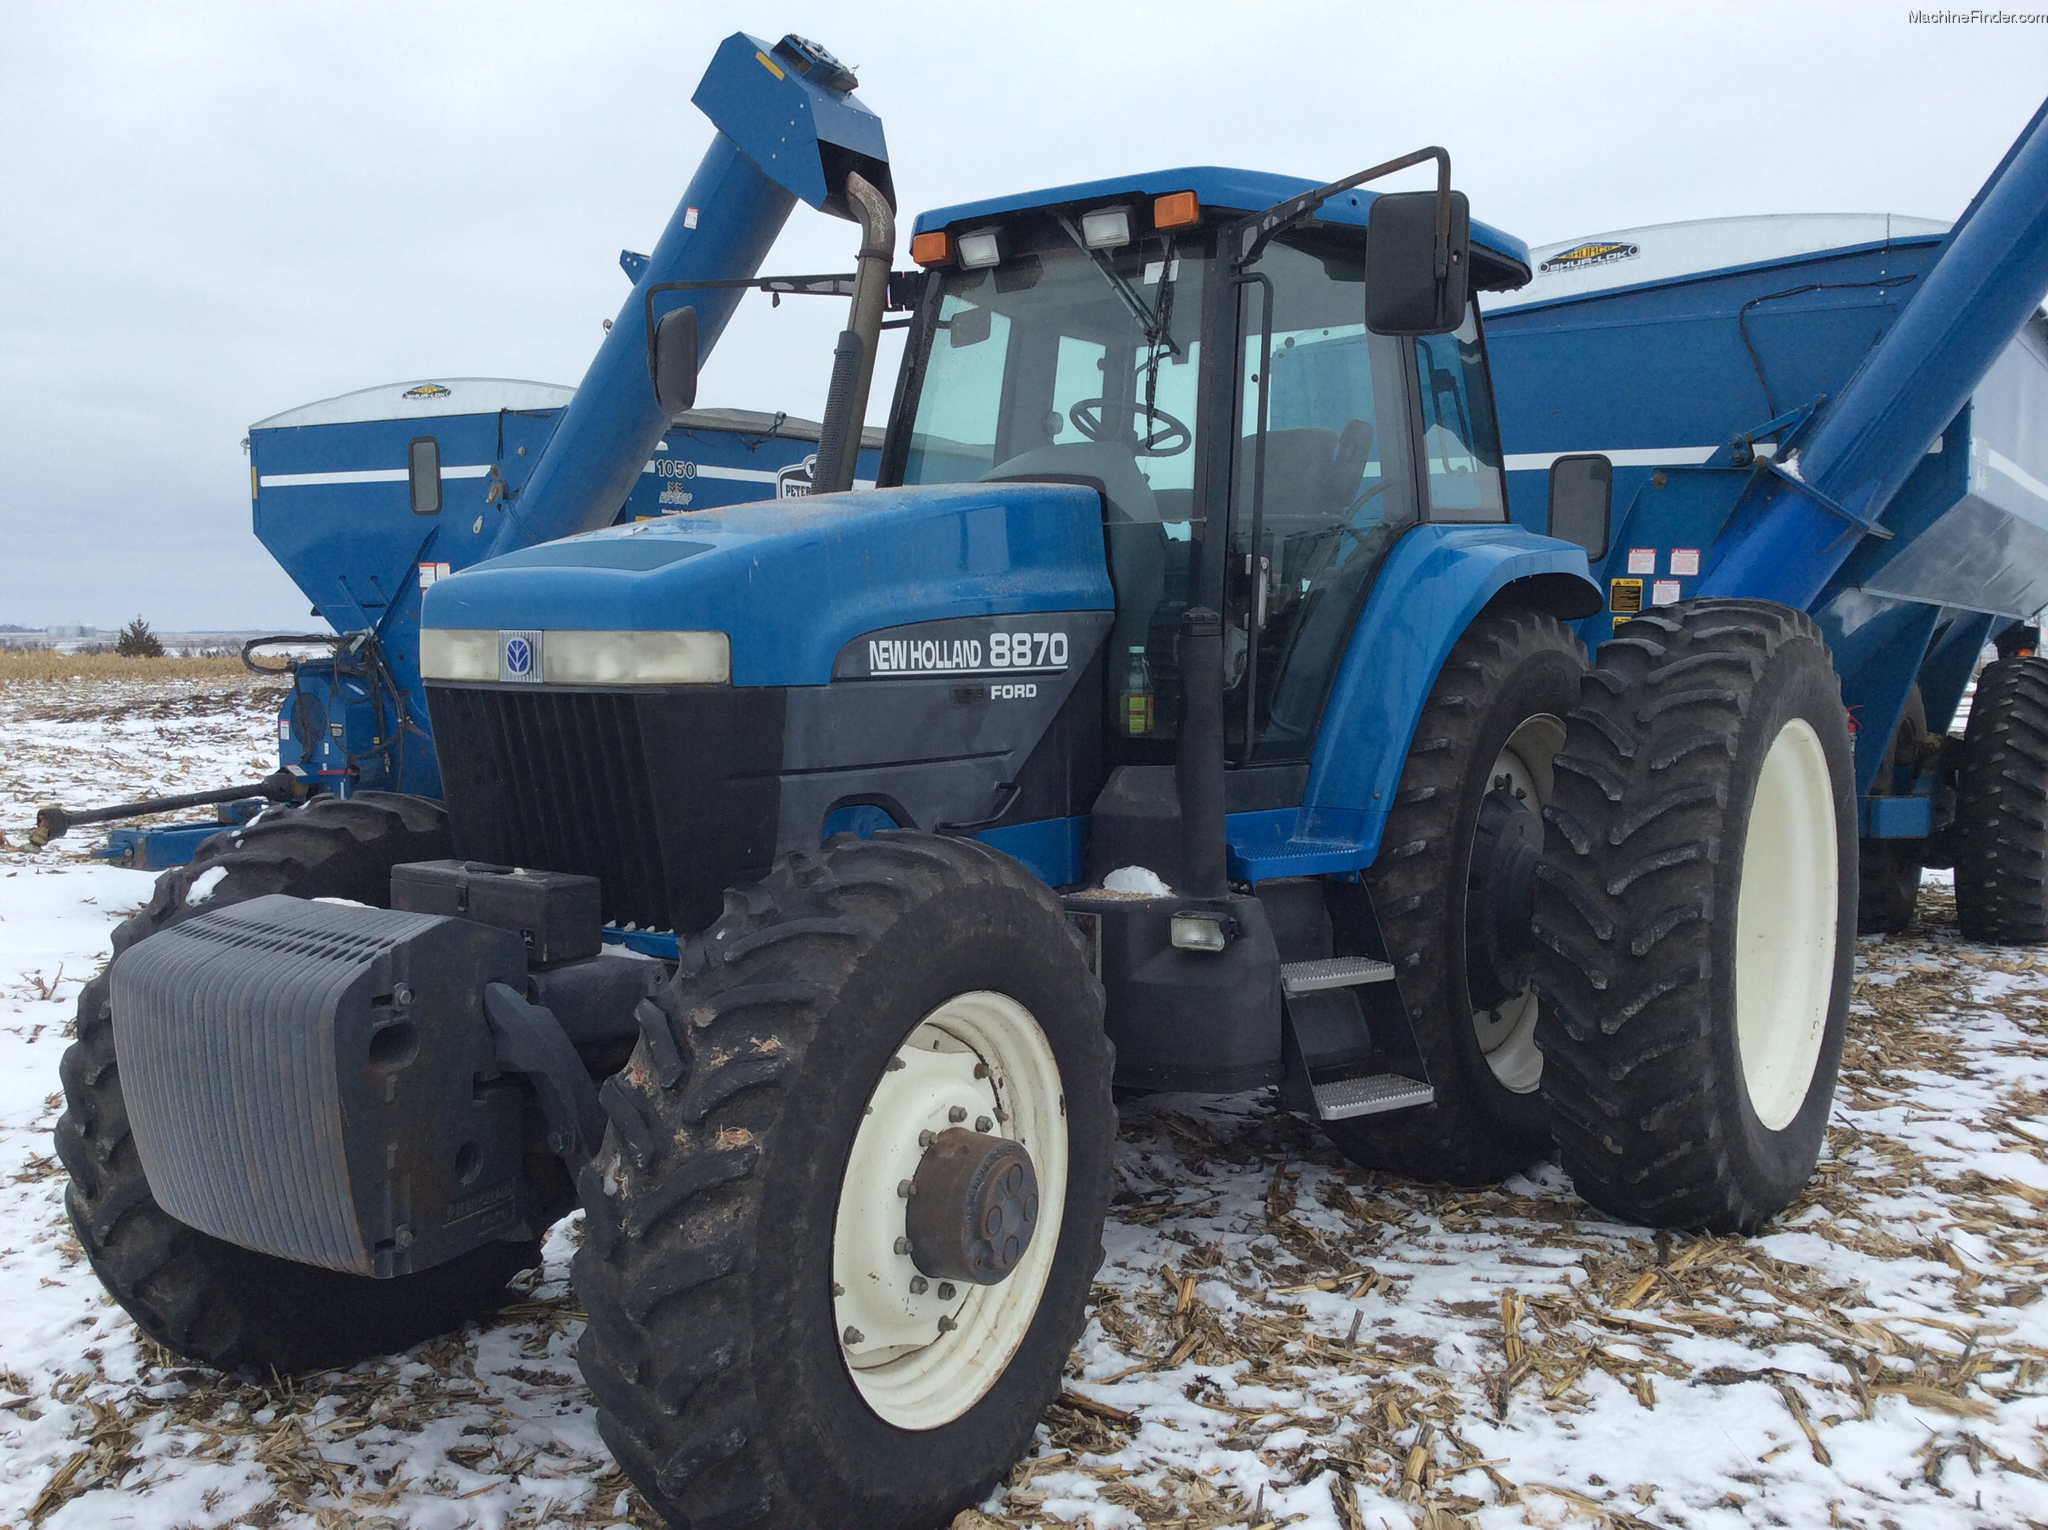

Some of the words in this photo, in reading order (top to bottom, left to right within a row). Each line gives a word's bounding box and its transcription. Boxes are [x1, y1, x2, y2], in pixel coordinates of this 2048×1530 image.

[1549, 249, 1628, 272] SHUR-LOK
[656, 459, 697, 479] 1050
[869, 640, 908, 670] NEW
[910, 639, 982, 669] HOLLAND
[989, 632, 1069, 666] 8870
[990, 684, 1037, 699] FORD
